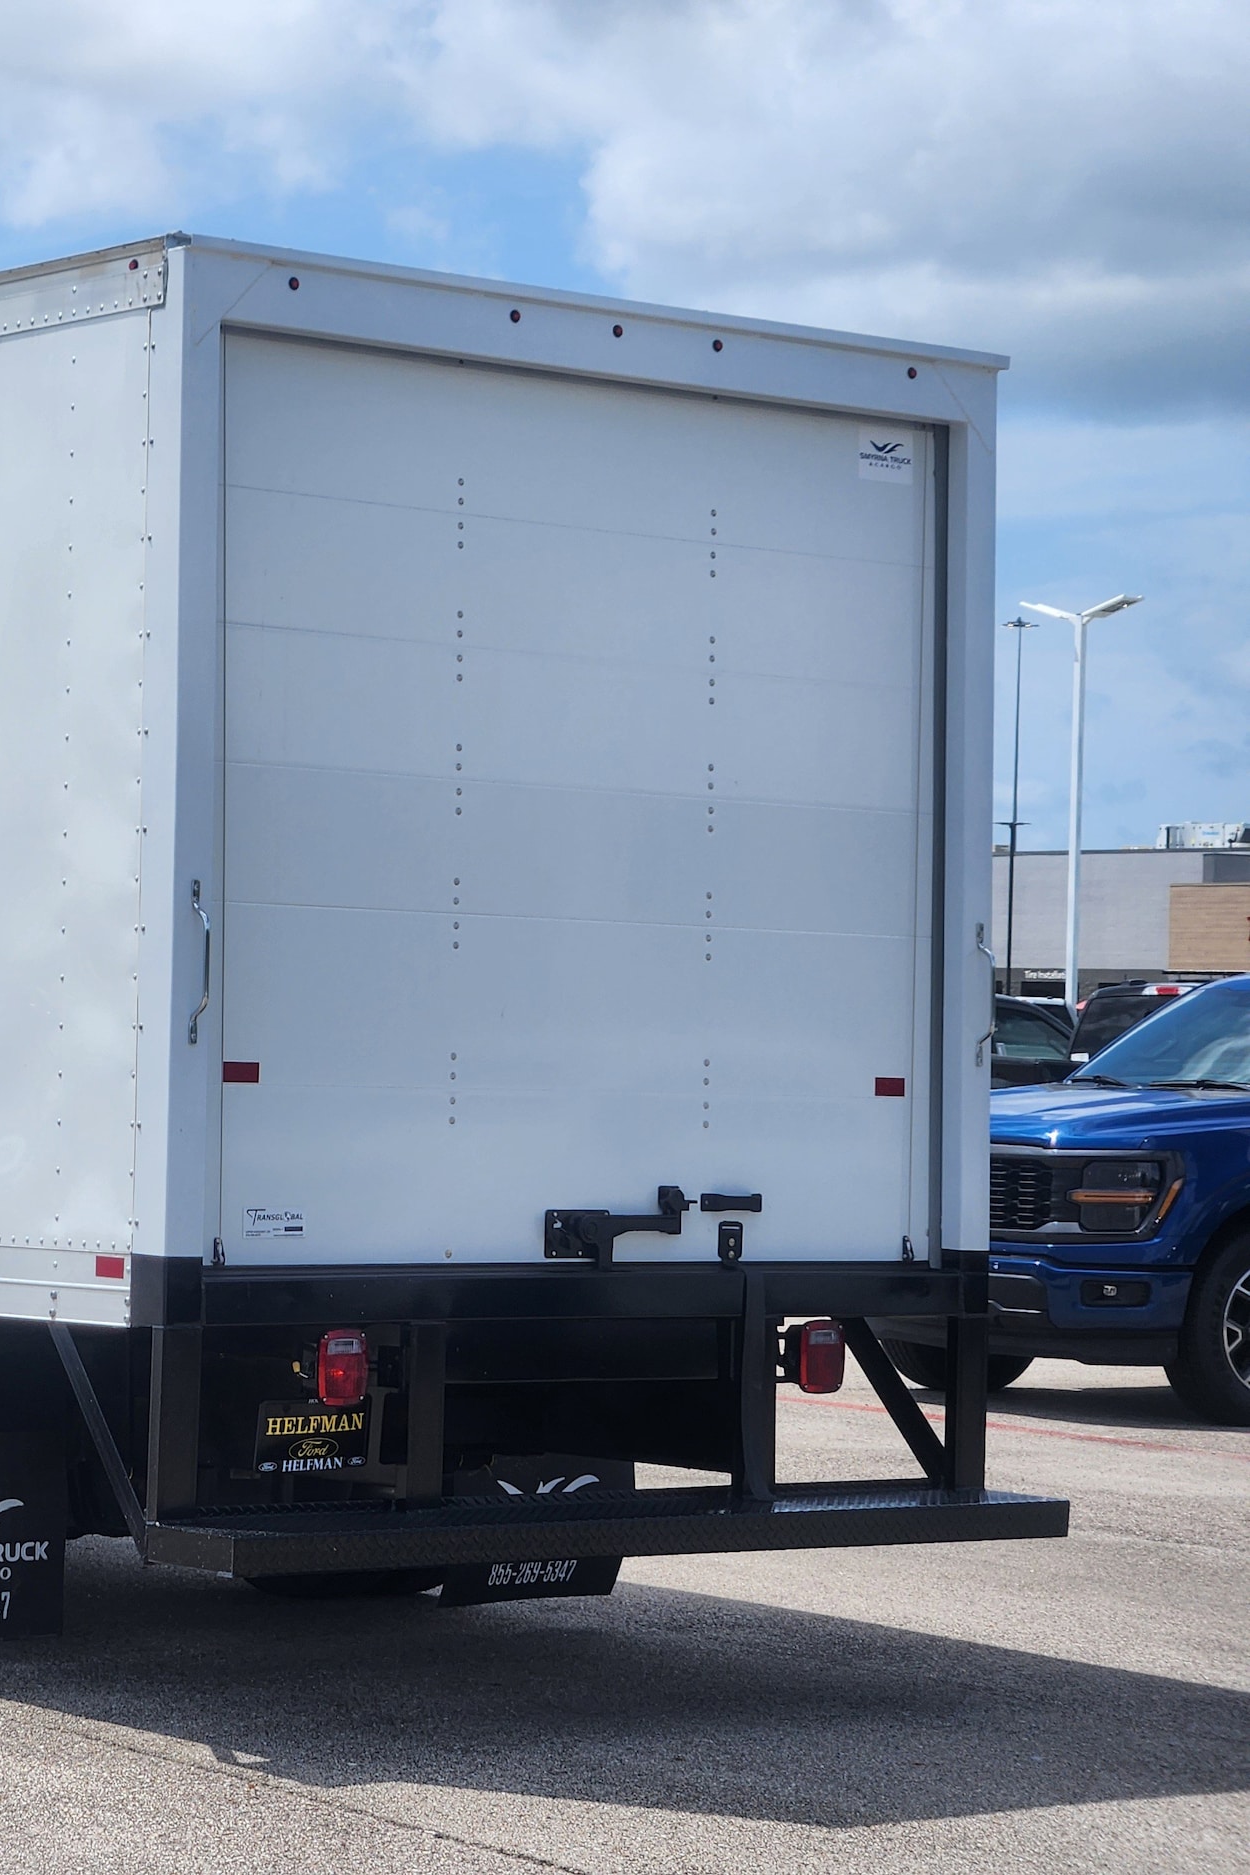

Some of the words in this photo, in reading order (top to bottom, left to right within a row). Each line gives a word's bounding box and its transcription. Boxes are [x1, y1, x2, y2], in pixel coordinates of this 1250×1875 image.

[859, 452, 888, 463] SMYRNA
[890, 457, 912, 465] TRUCK
[266, 1412, 365, 1436] HELFMAN
[297, 1440, 330, 1457] Ford
[282, 1457, 343, 1472] HELFMAN
[488, 1559, 578, 1586] 855-269-5347
